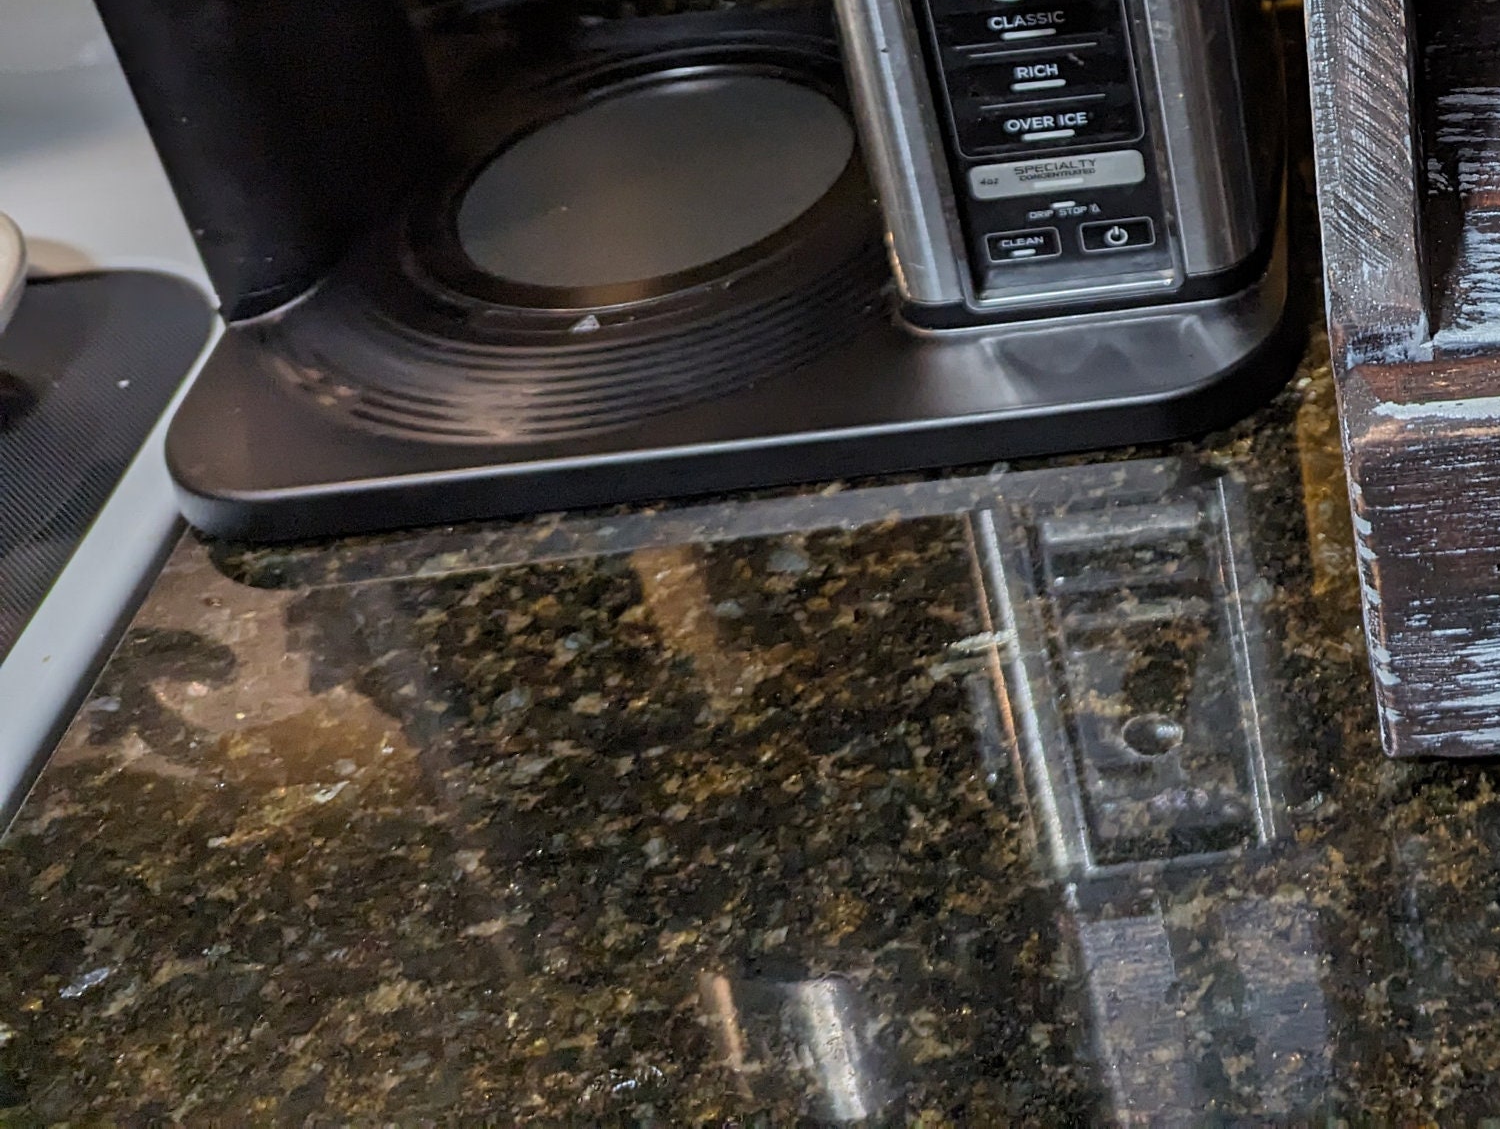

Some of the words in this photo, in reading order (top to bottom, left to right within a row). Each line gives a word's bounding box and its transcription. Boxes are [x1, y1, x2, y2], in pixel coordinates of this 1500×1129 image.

[987, 10, 1066, 31] CLASSIC
[1014, 62, 1060, 81] RICH
[1003, 115, 1056, 134] OVER
[1058, 111, 1089, 127] ICE
[1014, 158, 1098, 175] SPECIALTY
[1028, 210, 1054, 220] DRIP
[1058, 205, 1088, 217] STOP
[1001, 235, 1045, 249] CLEAN
